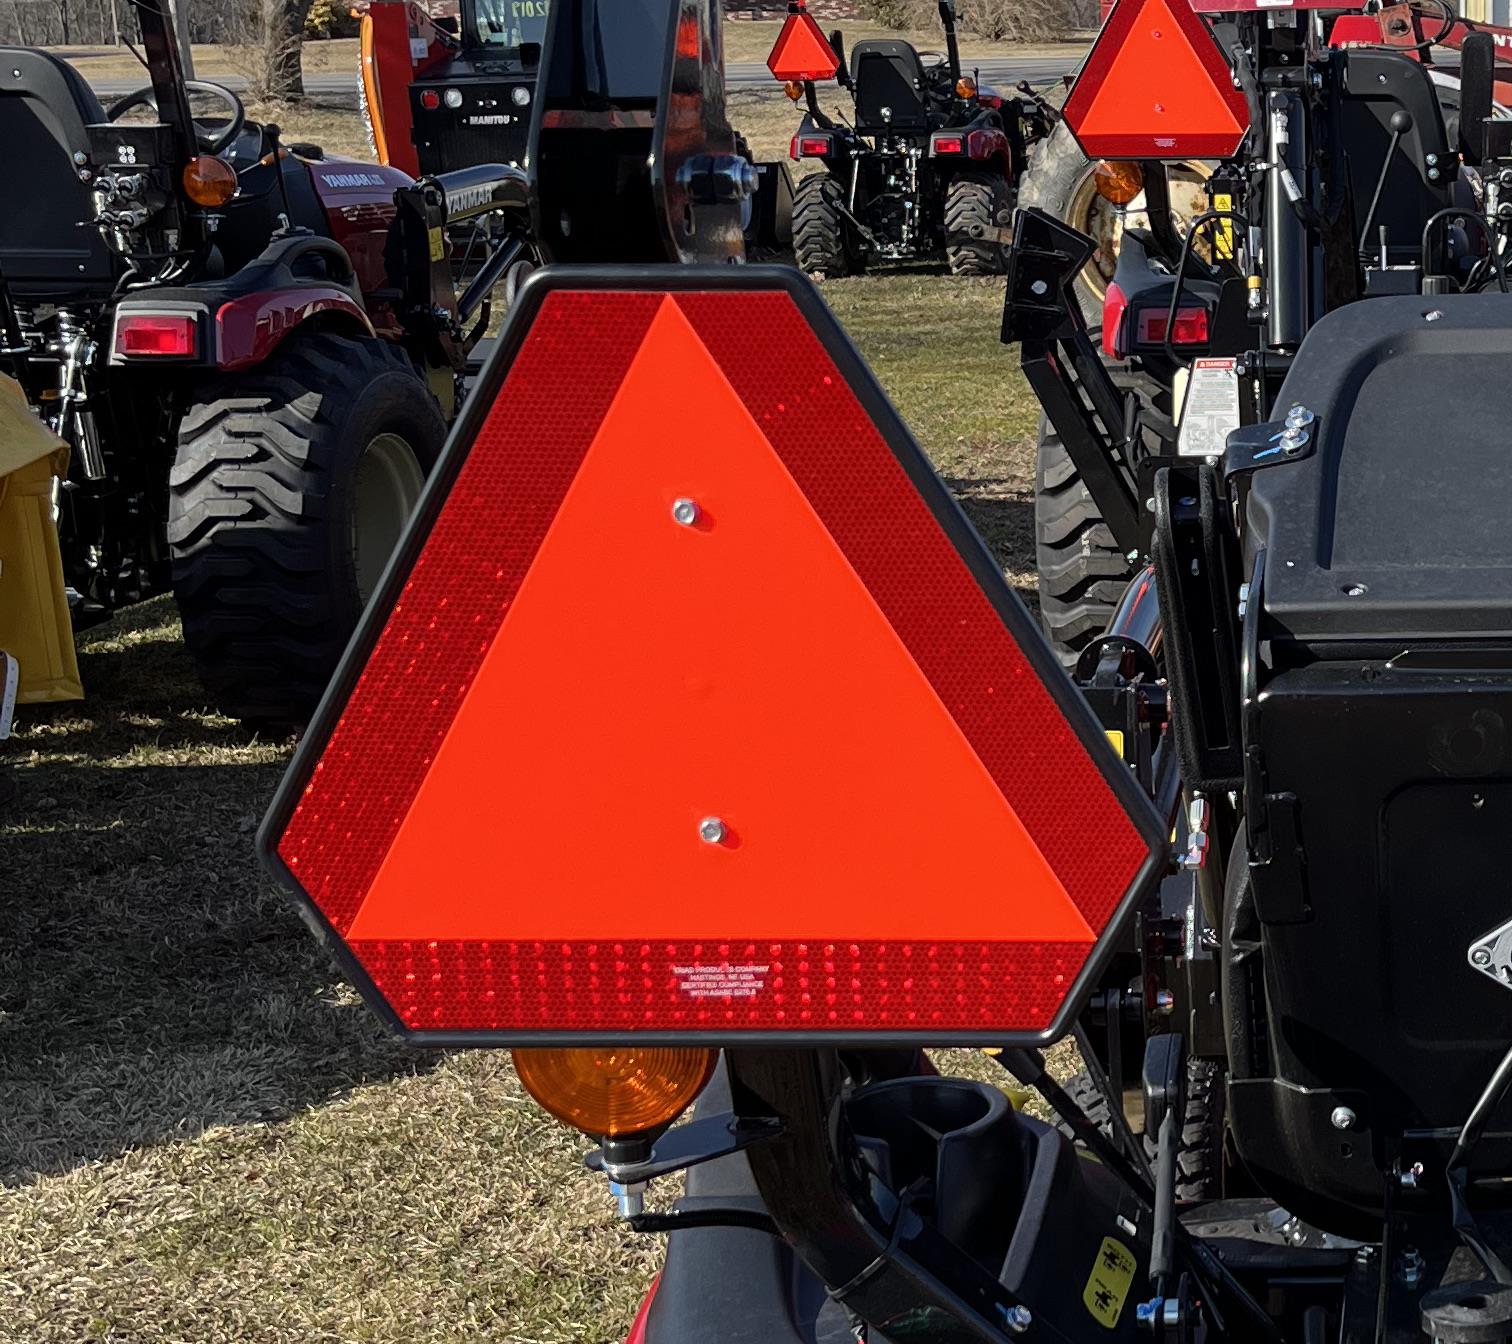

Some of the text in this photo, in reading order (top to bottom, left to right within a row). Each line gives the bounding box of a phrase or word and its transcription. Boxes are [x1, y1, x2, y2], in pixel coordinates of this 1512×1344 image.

[470, 115, 510, 125] MANITOU
[321, 174, 371, 187] YANMAR
[446, 186, 492, 214] YANMAR
